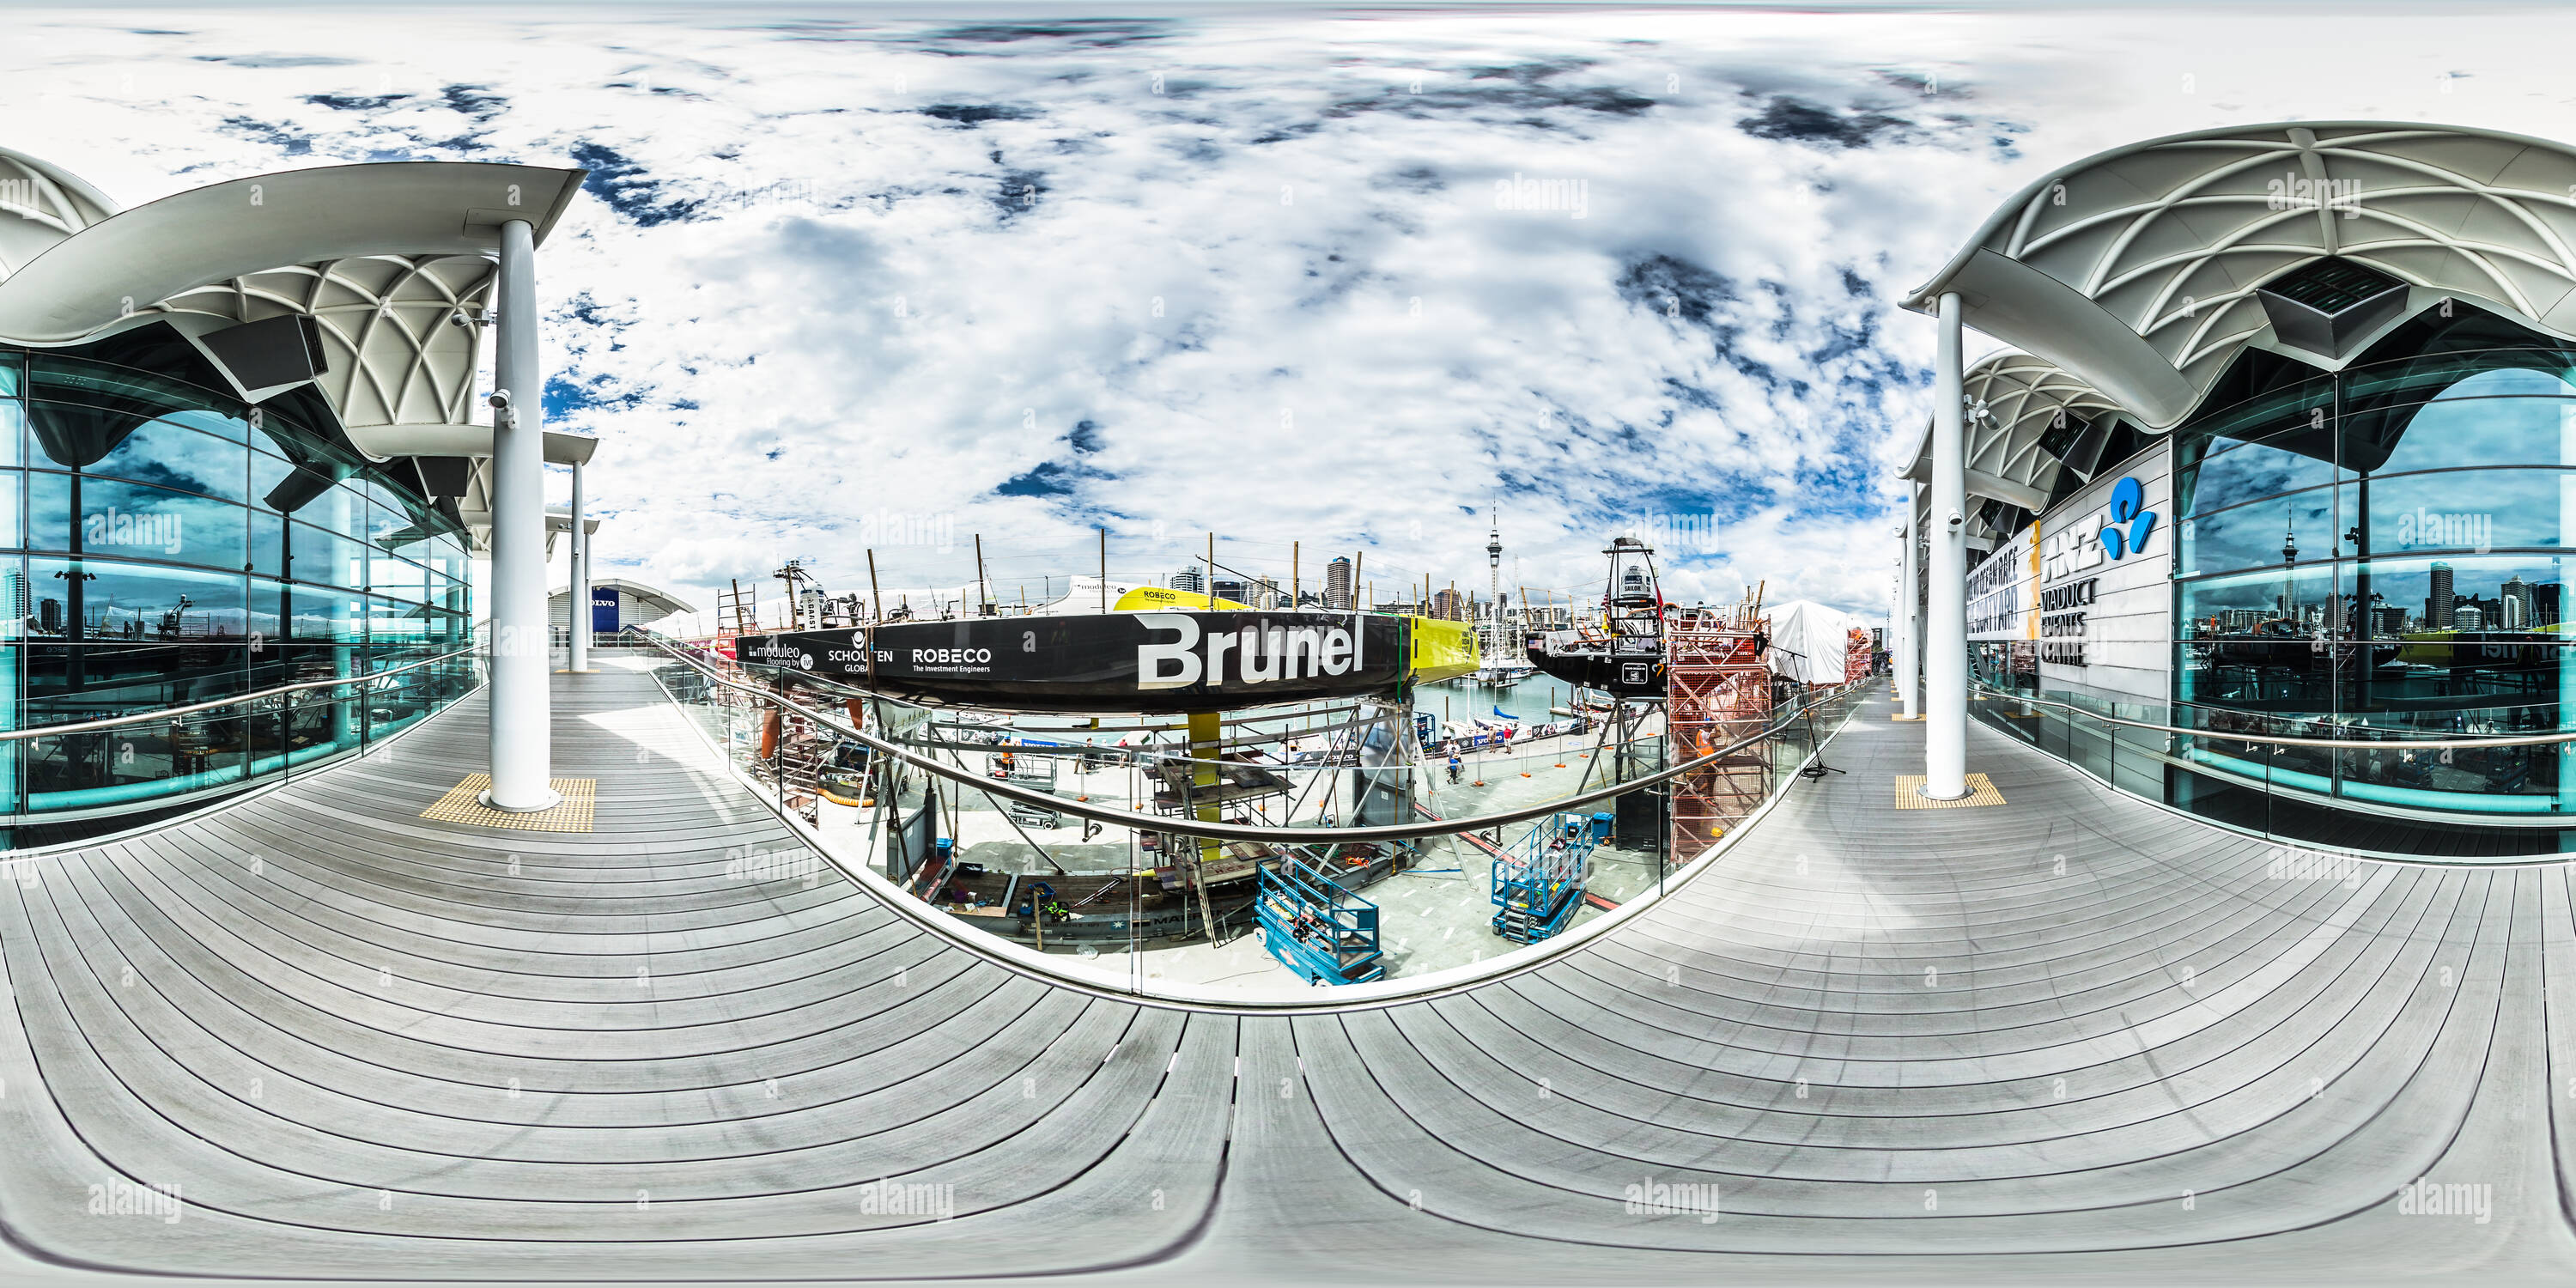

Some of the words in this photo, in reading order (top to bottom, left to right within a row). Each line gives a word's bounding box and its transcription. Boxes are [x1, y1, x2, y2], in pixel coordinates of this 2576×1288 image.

[2041, 513, 2103, 583] ANZ
[1980, 559, 1997, 595] OCEAN
[1999, 545, 2018, 586] RACE
[1144, 591, 1176, 600] ROBECO
[2041, 578, 2099, 611] VIADUCT
[1977, 586, 2018, 634] BOATYARD
[2041, 611, 2087, 637] EVENTS
[756, 644, 800, 658] moduleo
[912, 648, 992, 663] ROBECO
[1133, 614, 1364, 690] Brunel
[766, 658, 791, 667] Flooring
[792, 659, 800, 669] by
[959, 665, 990, 673] Engineers
[1154, 909, 1224, 925] MAERK
